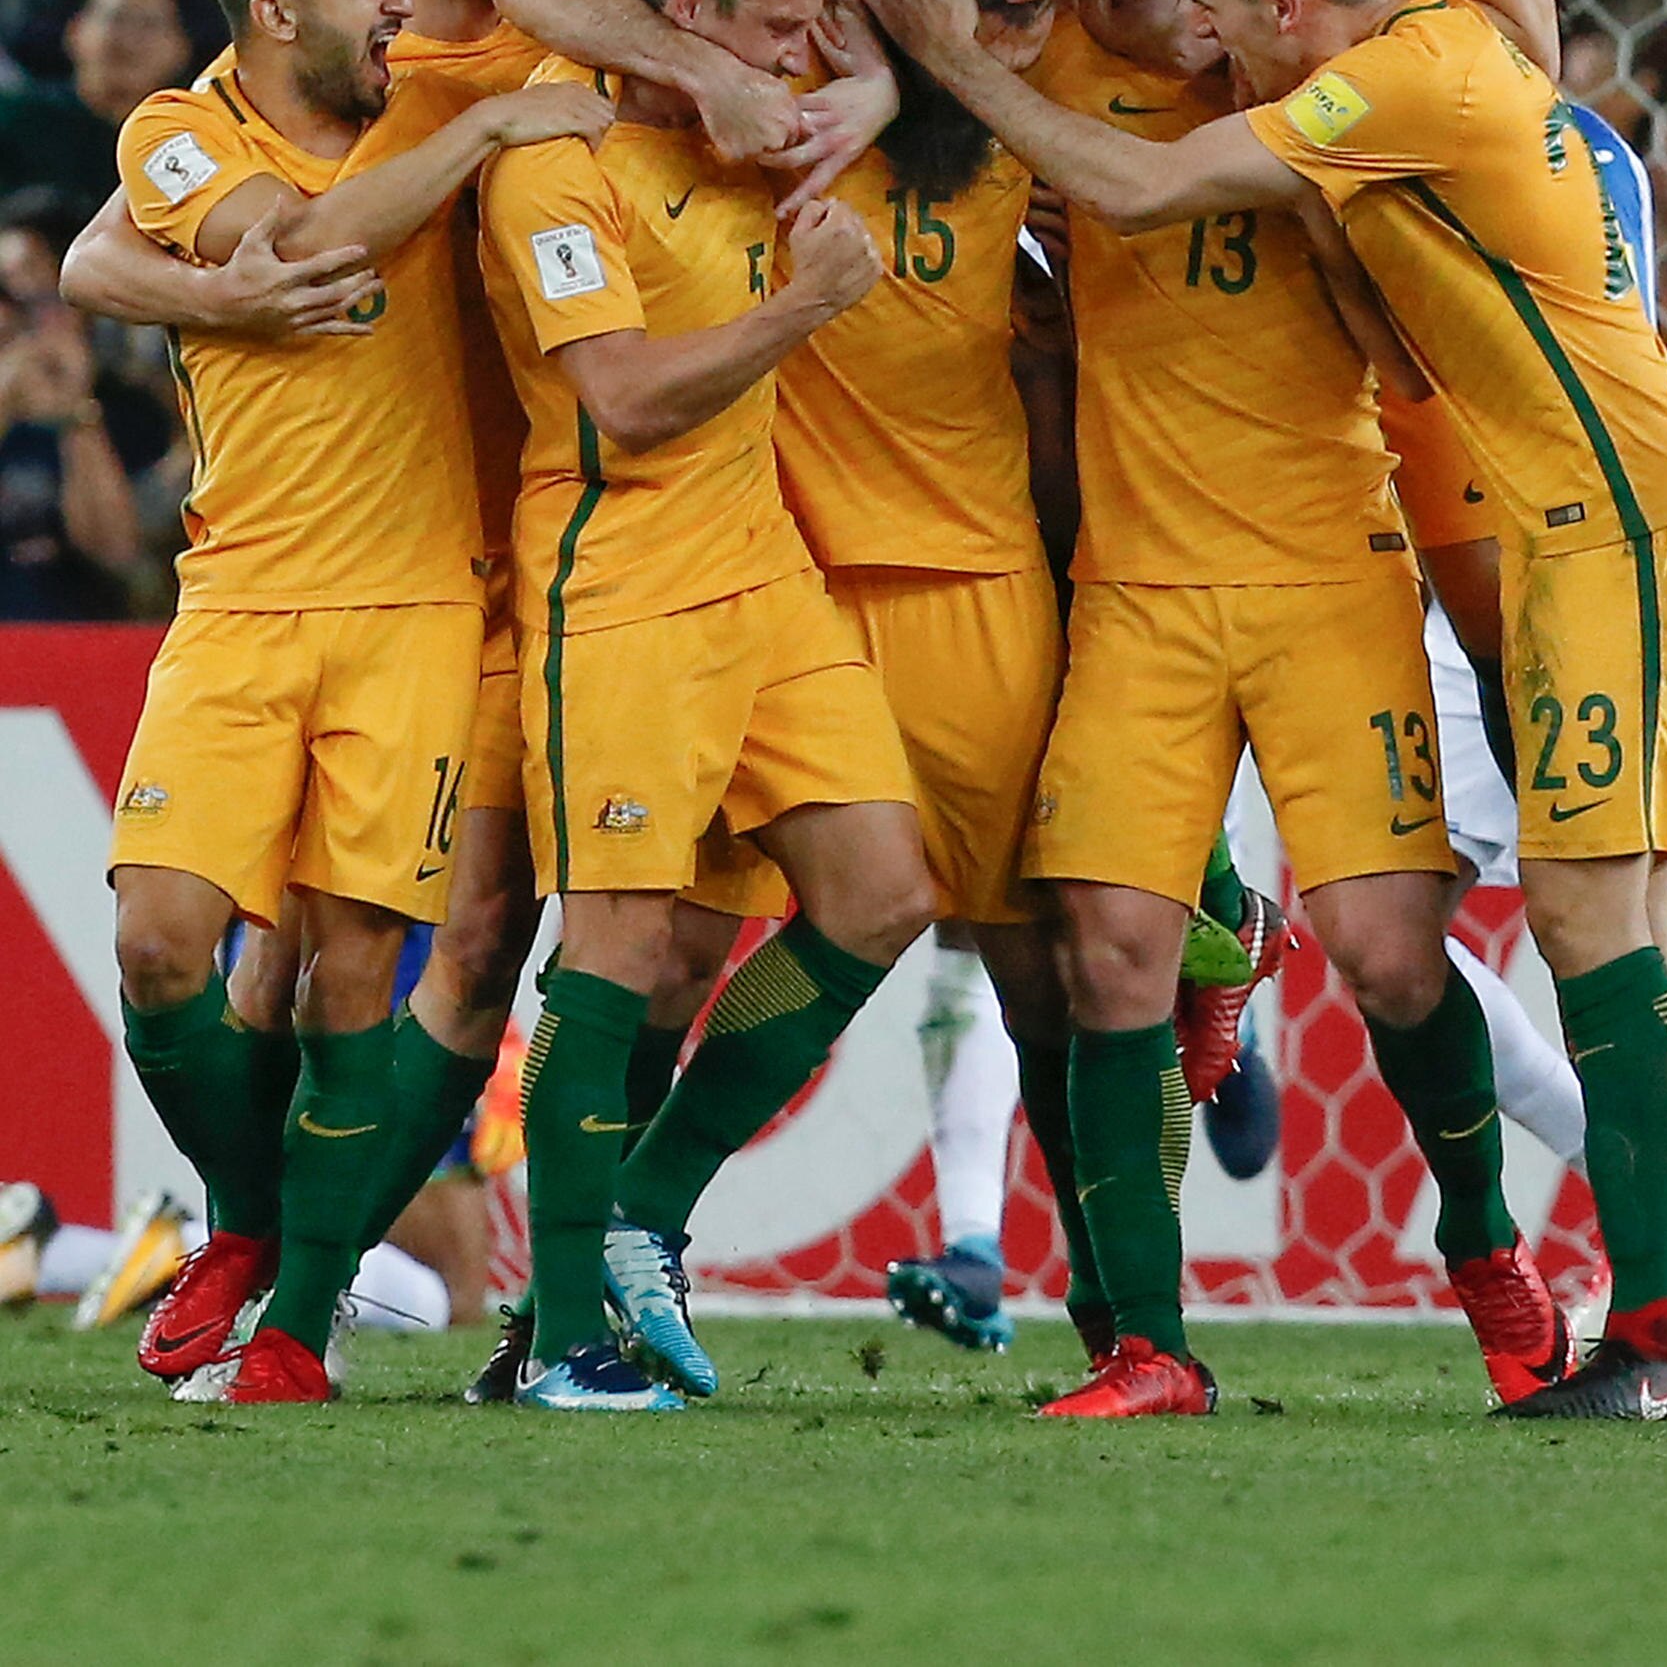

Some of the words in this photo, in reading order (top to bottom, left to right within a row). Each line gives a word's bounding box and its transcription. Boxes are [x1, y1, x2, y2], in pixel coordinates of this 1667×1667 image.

[1307, 81, 1337, 116] FIFA
[888, 187, 955, 282] 15
[1187, 210, 1257, 295] 13
[1370, 710, 1437, 803] 13
[1530, 693, 1622, 790] 23
[426, 756, 464, 856] 16
